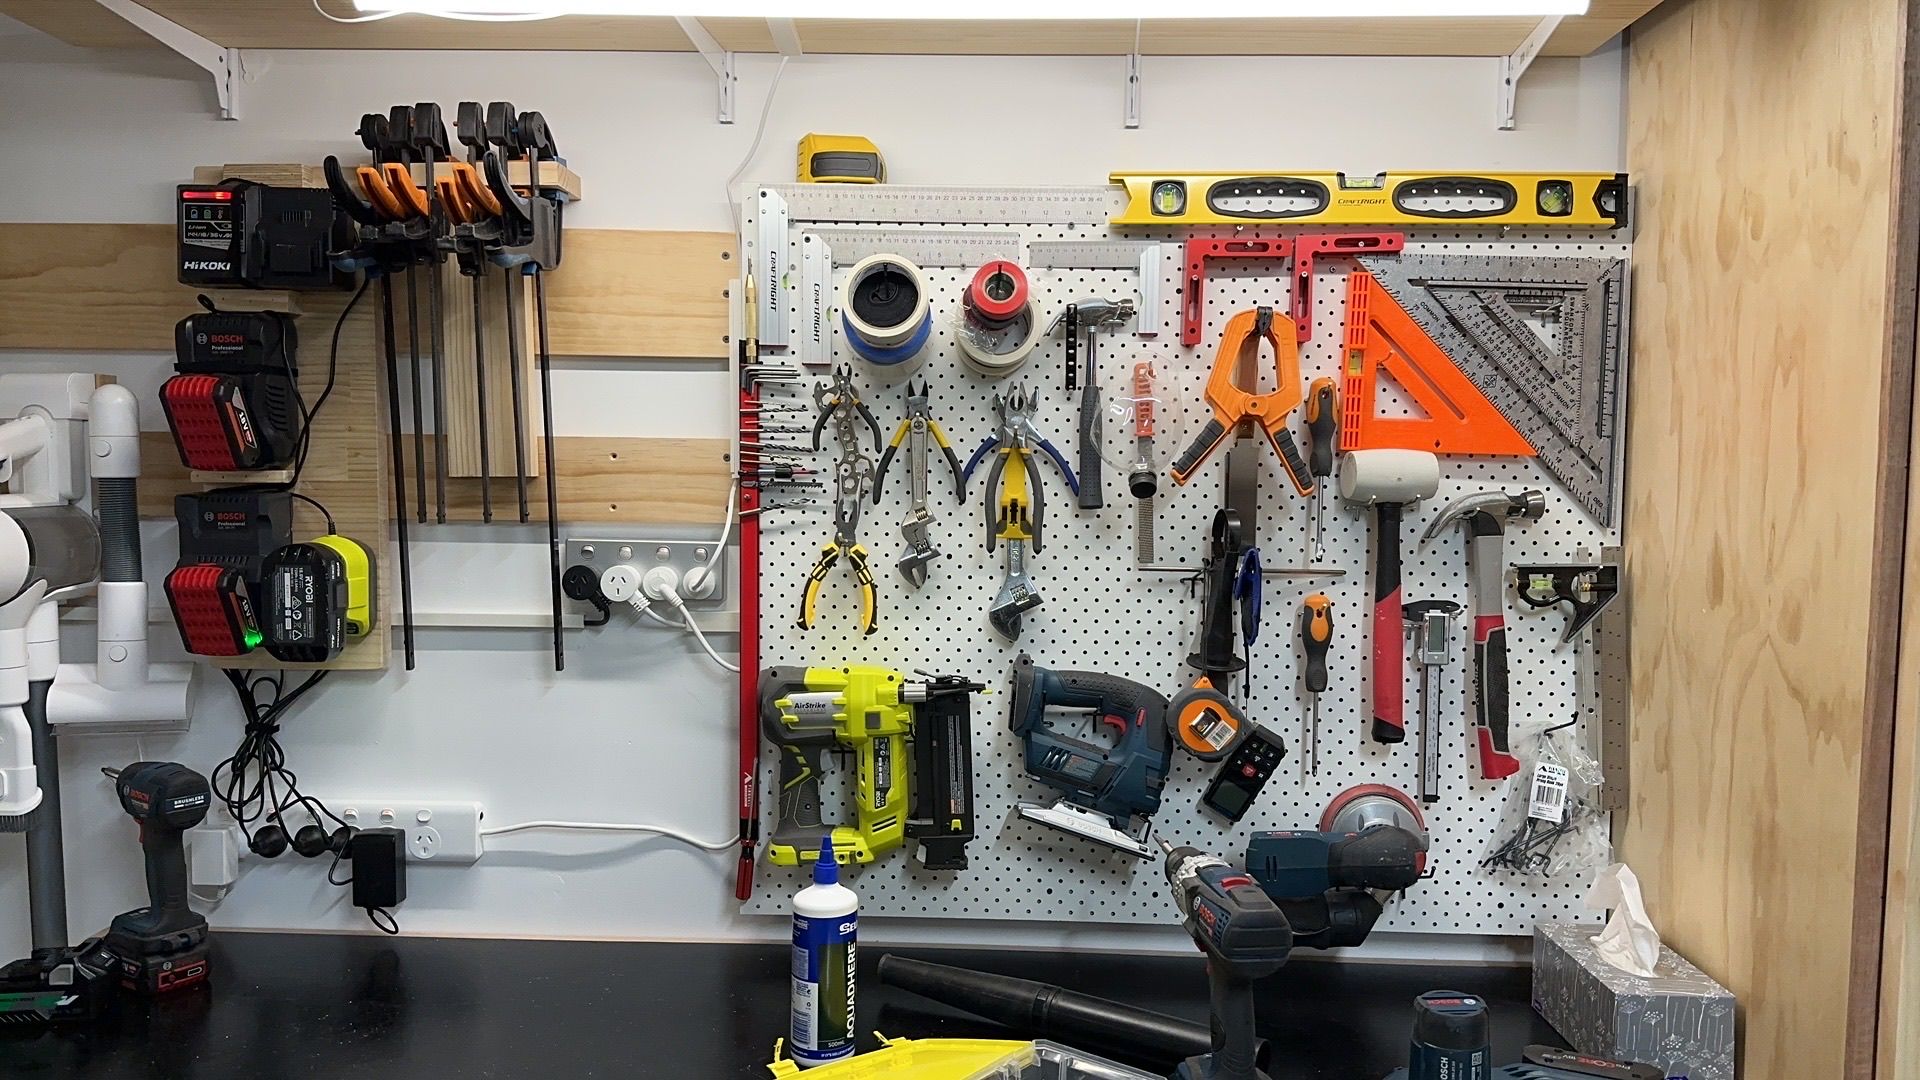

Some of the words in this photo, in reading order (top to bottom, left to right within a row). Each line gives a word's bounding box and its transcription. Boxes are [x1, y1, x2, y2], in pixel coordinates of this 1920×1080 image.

[184, 261, 231, 270] HiKOKI
[239, 412, 248, 430] 18V
[305, 576, 313, 602] RYOBI
[242, 600, 251, 617] 18V
[174, 795, 204, 805] BRUSHLESS
[847, 942, 855, 1038] AQUADHERE
[1440, 1057, 1448, 1080] OSCH
